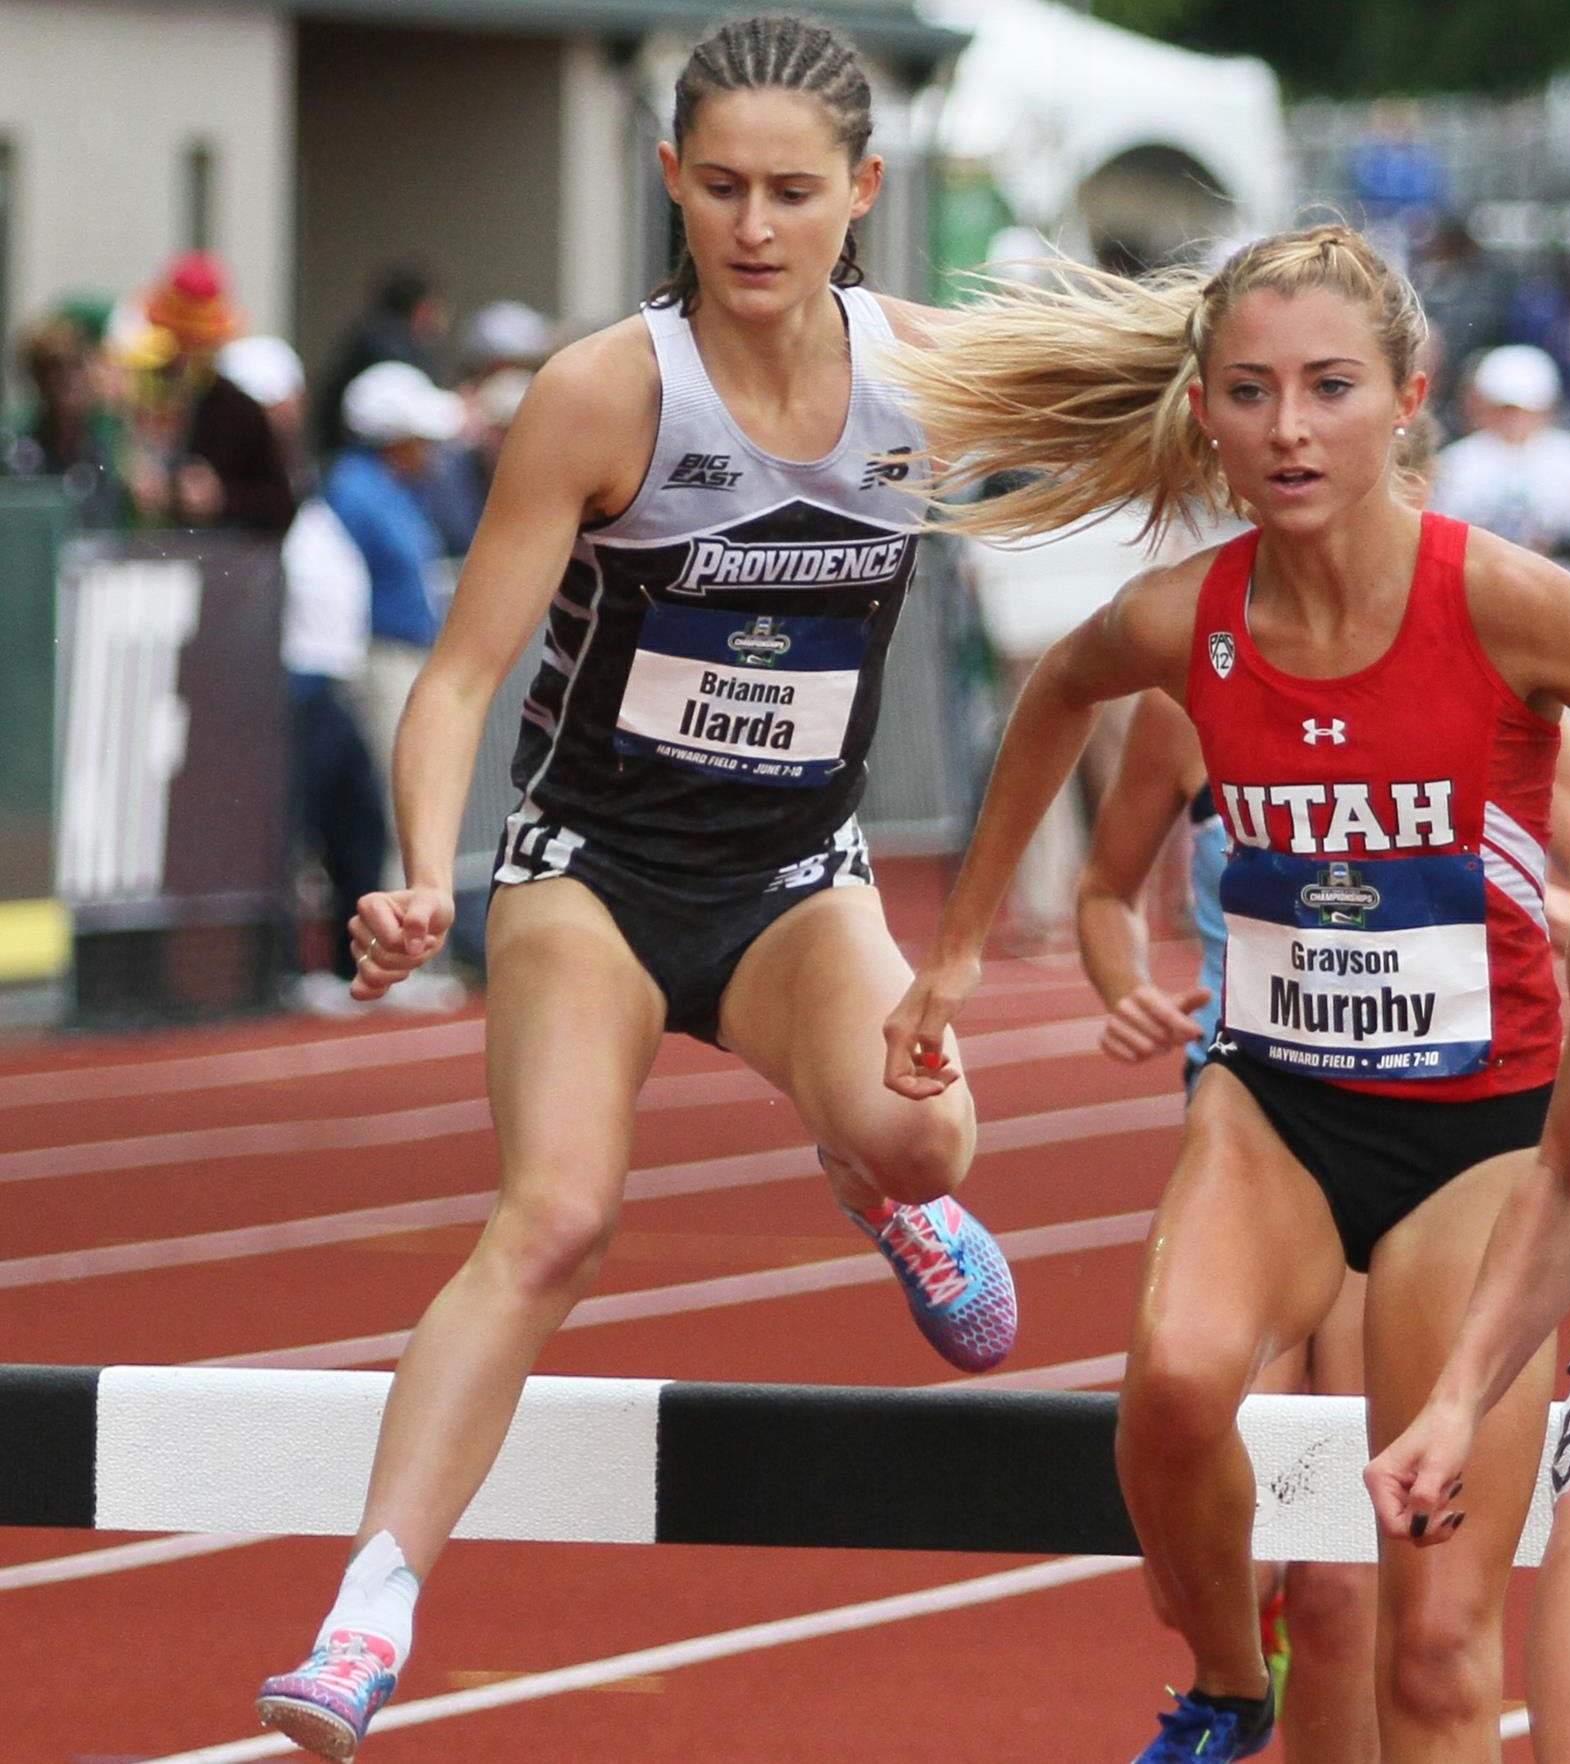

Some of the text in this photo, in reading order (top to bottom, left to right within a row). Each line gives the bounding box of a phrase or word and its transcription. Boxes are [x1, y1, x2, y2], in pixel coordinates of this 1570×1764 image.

[678, 453, 731, 470] BIG
[667, 471, 744, 489] EAST
[682, 538, 905, 590] PROVIDENCE
[1215, 652, 1230, 669] 12
[699, 670, 795, 705] Brianna
[678, 699, 796, 750] Ilarda
[656, 744, 804, 778] HAYWARD FIELD JUNE 7-10
[1221, 780, 1456, 854] UTAH
[1291, 940, 1399, 976] Grayson
[1270, 974, 1436, 1041] Murphy
[1269, 1045, 1440, 1070] HAYWARD FIELD JUNE 7-10
